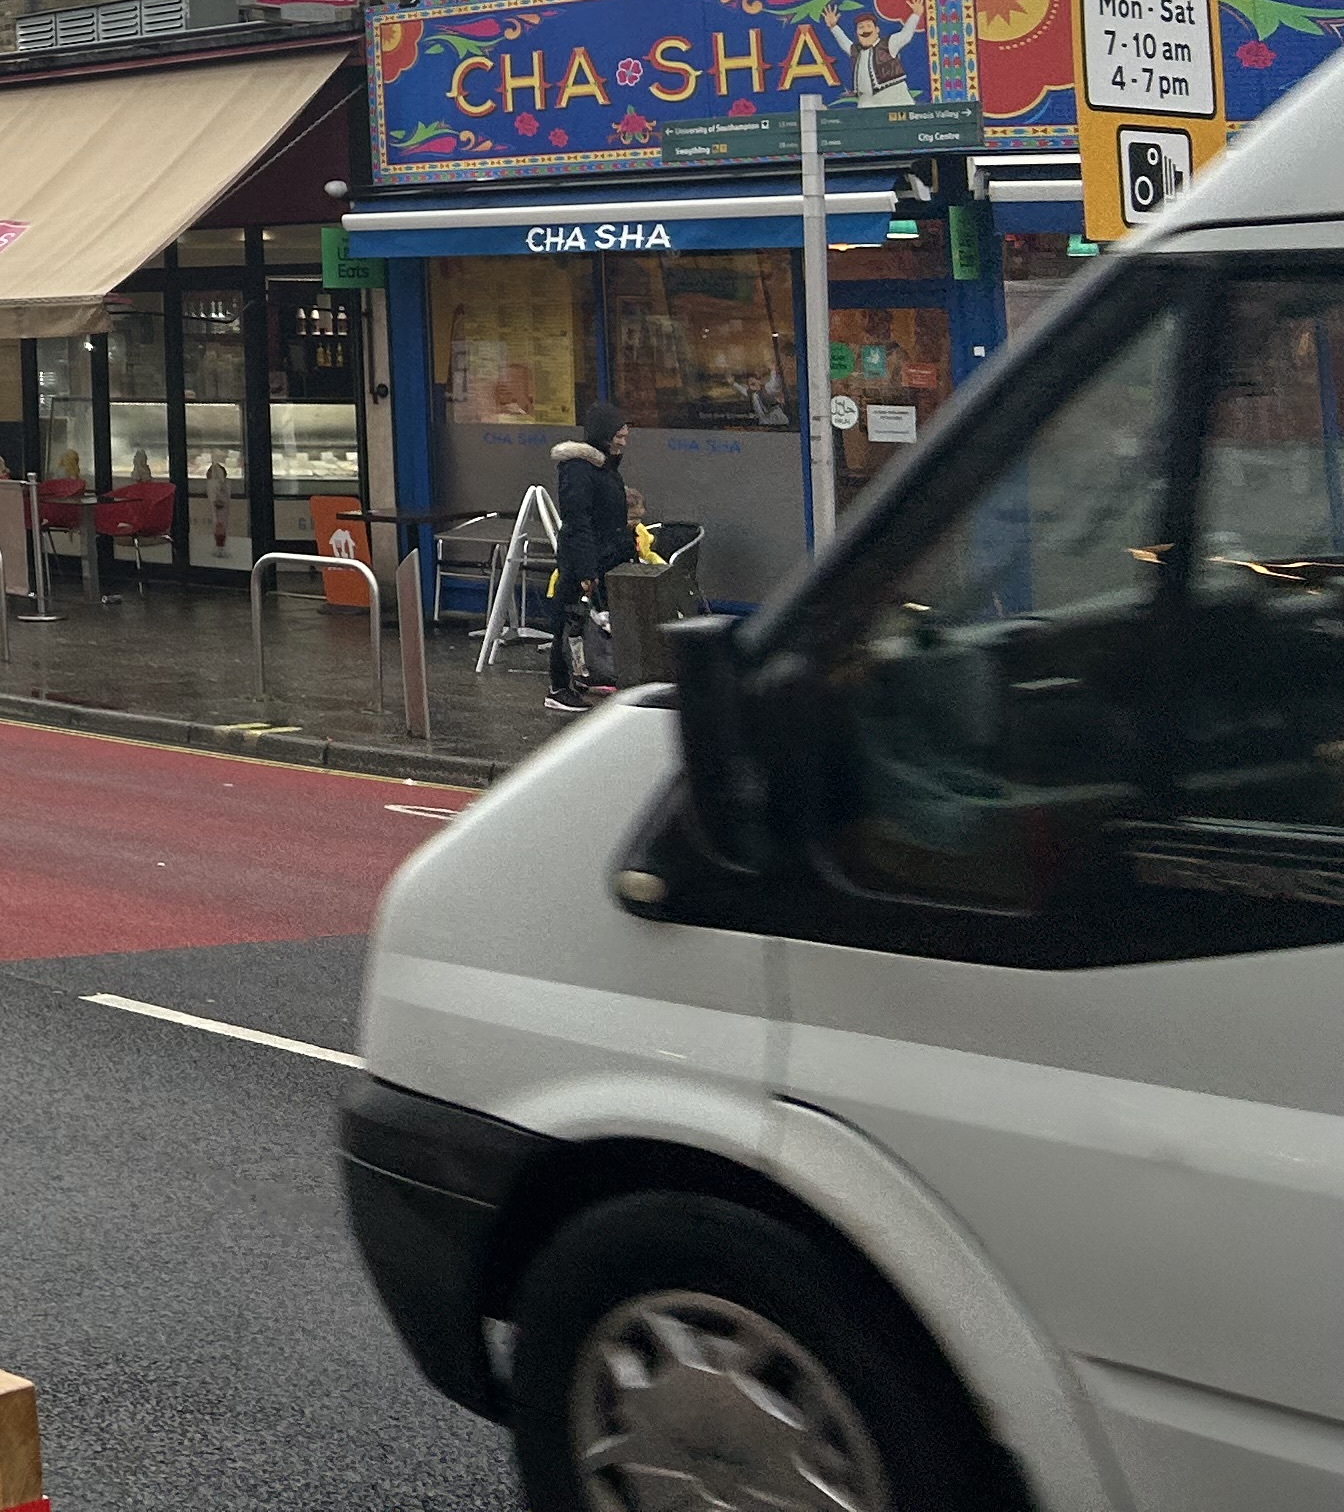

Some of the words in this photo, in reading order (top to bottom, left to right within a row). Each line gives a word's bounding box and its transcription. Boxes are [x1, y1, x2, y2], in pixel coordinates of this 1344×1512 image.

[1162, 41, 1192, 62] am
[446, 46, 611, 117] CHA
[643, 24, 841, 102] SHA
[1158, 75, 1190, 99] pm
[675, 127, 707, 136] University
[708, 124, 715, 133] of
[716, 123, 760, 133] Southampton
[918, 133, 933, 142] City
[934, 132, 960, 141] Centre
[525, 226, 586, 253] CHA
[594, 223, 671, 250] SHA
[338, 264, 369, 278] Eats
